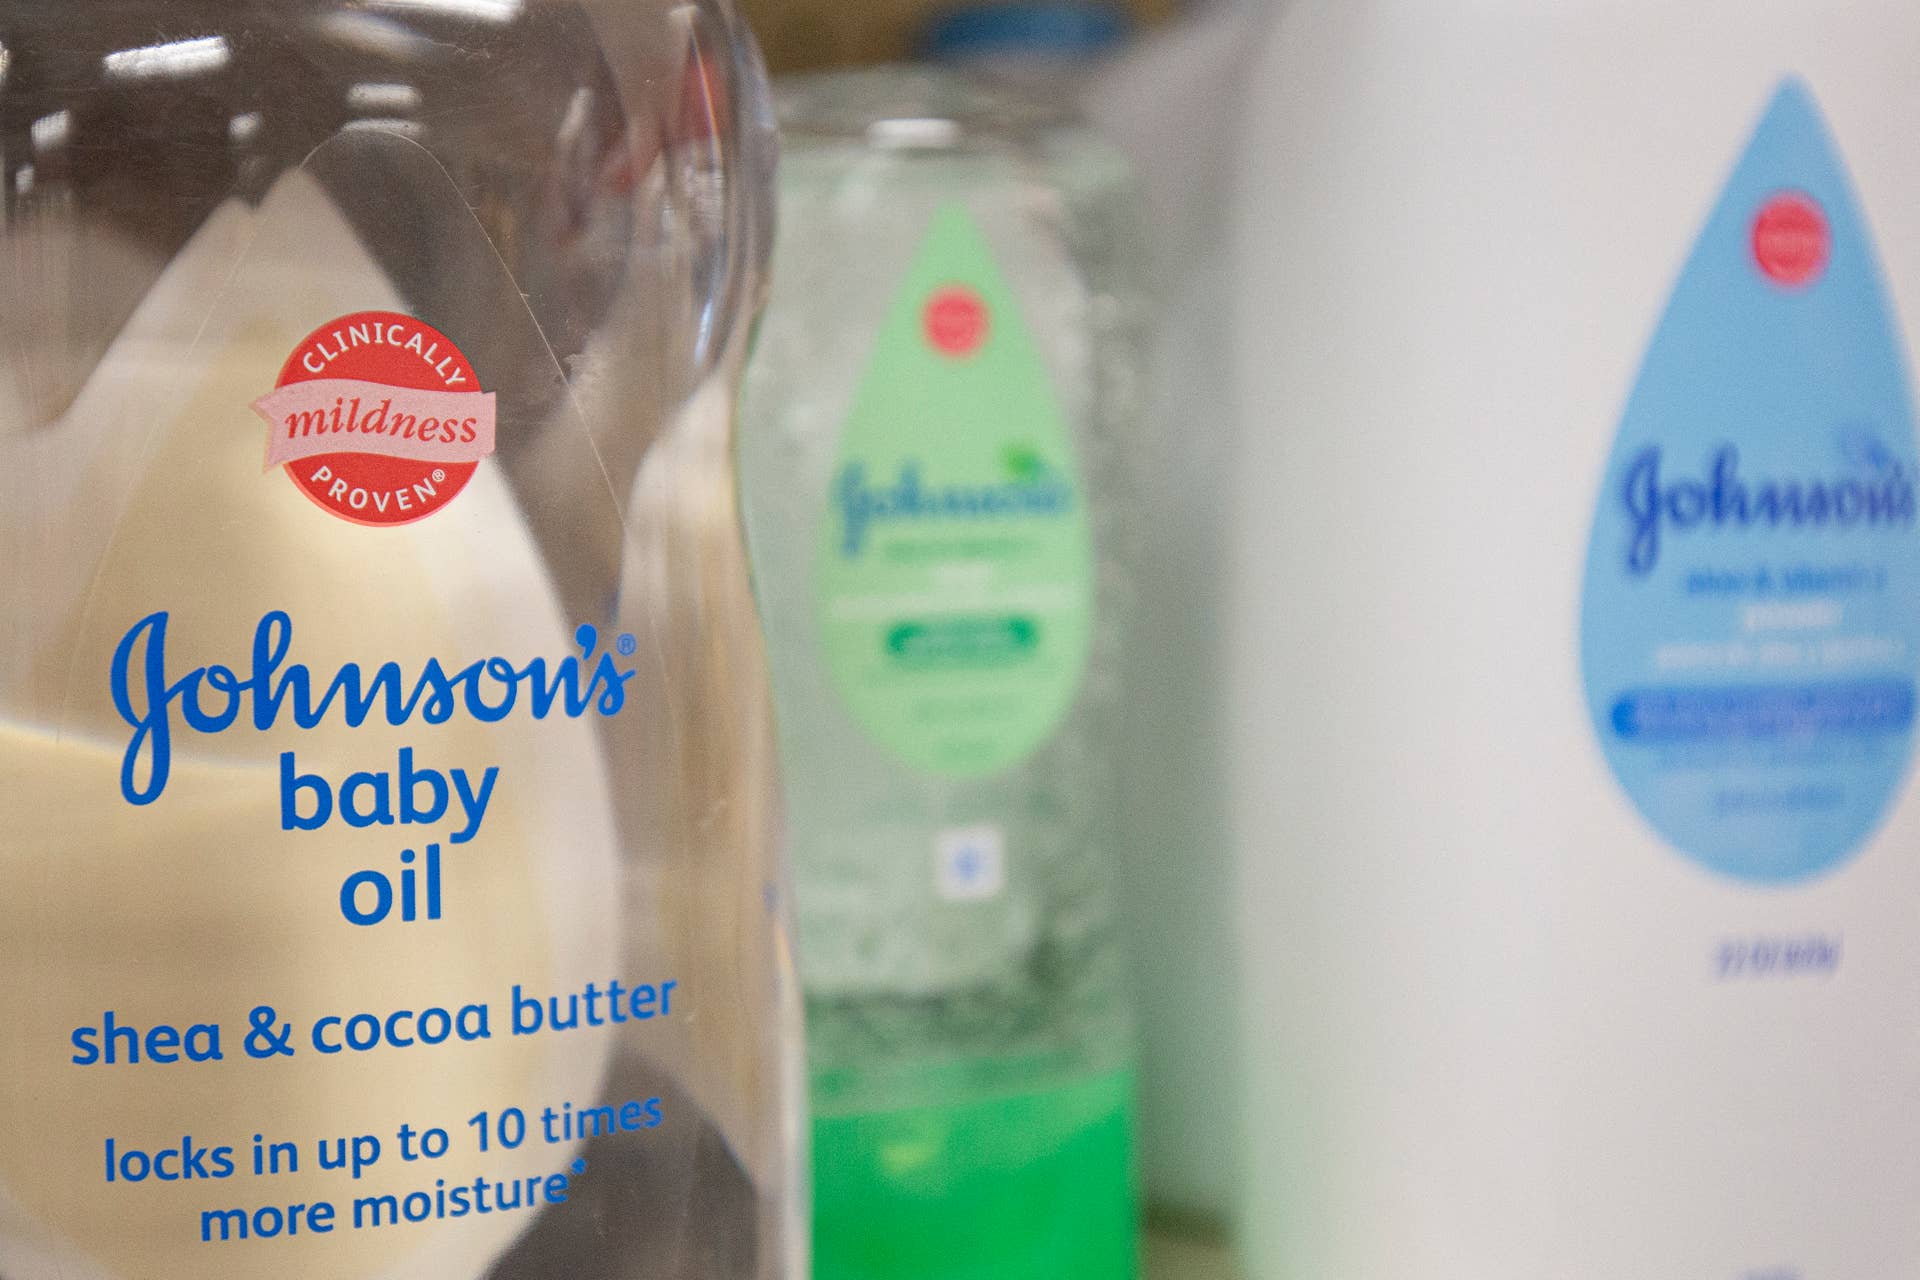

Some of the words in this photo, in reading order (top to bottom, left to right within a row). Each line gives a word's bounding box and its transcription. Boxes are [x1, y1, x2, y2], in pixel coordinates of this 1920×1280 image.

[303, 322, 466, 385] CLINICALLY
[285, 397, 478, 444] mildness
[280, 747, 499, 844] baby
[340, 843, 441, 926] oil
[72, 1011, 223, 1065] shea
[244, 1006, 294, 1059] &
[312, 1004, 491, 1053] cocoa
[512, 980, 677, 1035] butter
[105, 1136, 234, 1182] locks
[253, 1134, 298, 1175] in
[319, 1136, 381, 1179] up
[398, 1124, 449, 1161] to
[469, 1108, 526, 1151] 10
[541, 1097, 663, 1143] times
[201, 1202, 335, 1241] more
